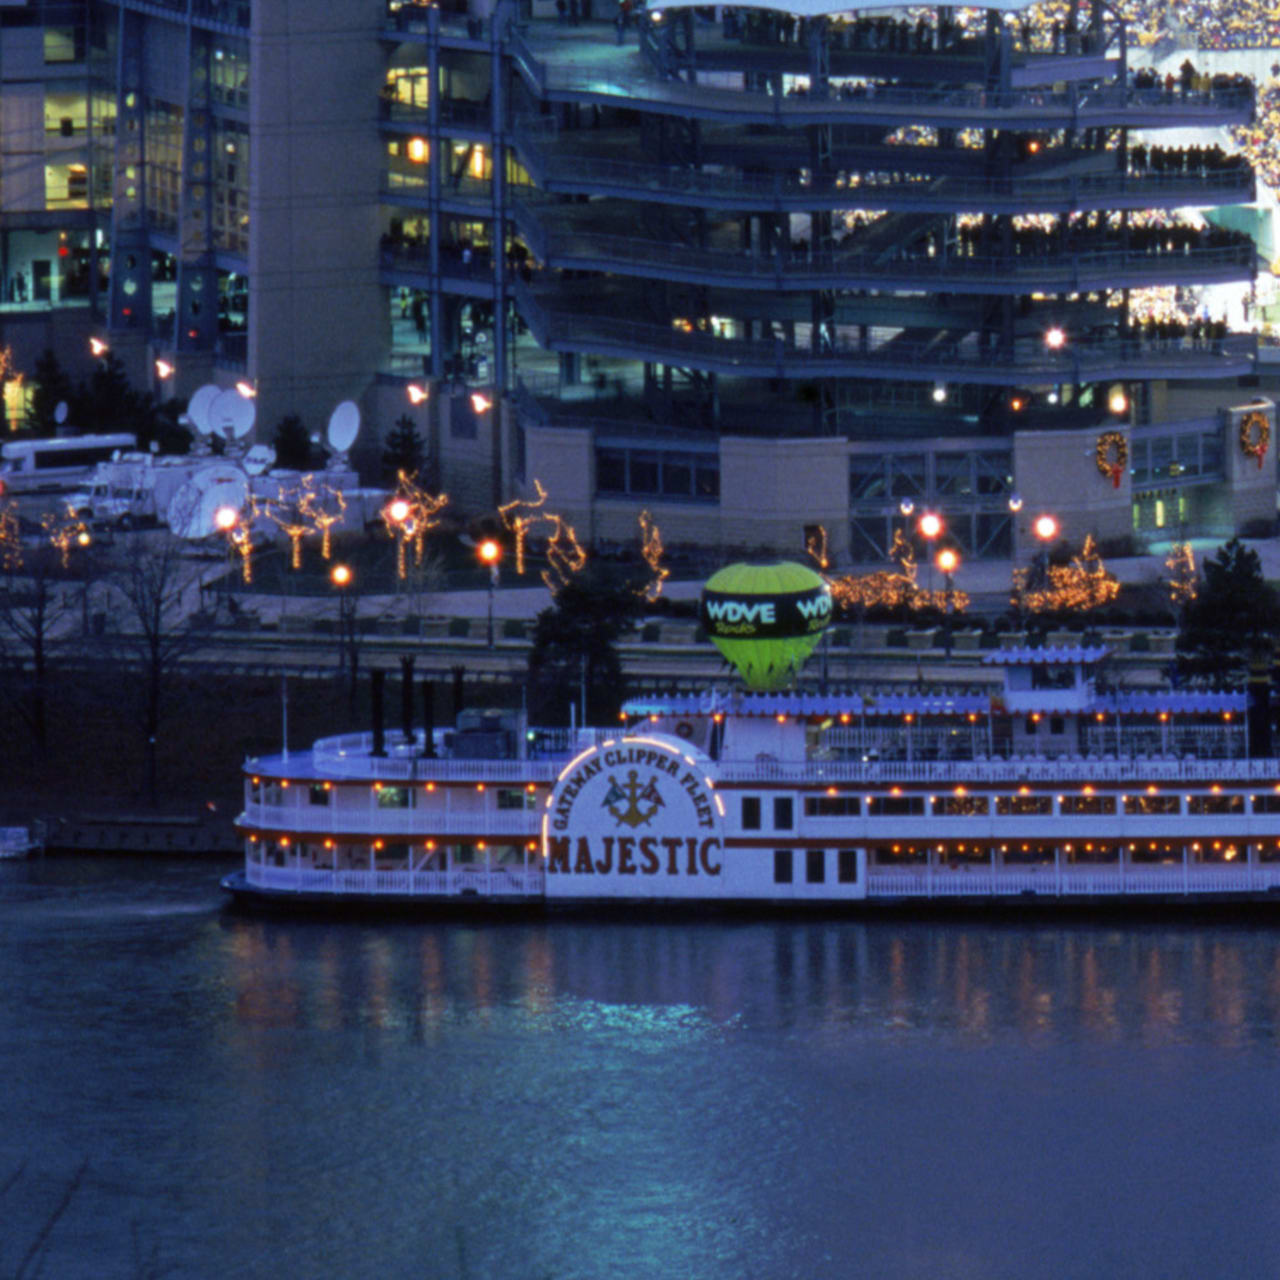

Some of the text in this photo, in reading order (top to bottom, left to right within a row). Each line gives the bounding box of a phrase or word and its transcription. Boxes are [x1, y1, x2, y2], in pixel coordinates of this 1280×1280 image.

[706, 600, 776, 624] WDVE
[553, 748, 714, 830] GATEWAY CLIPPER FLEET
[549, 836, 722, 876] MAJESTIC
